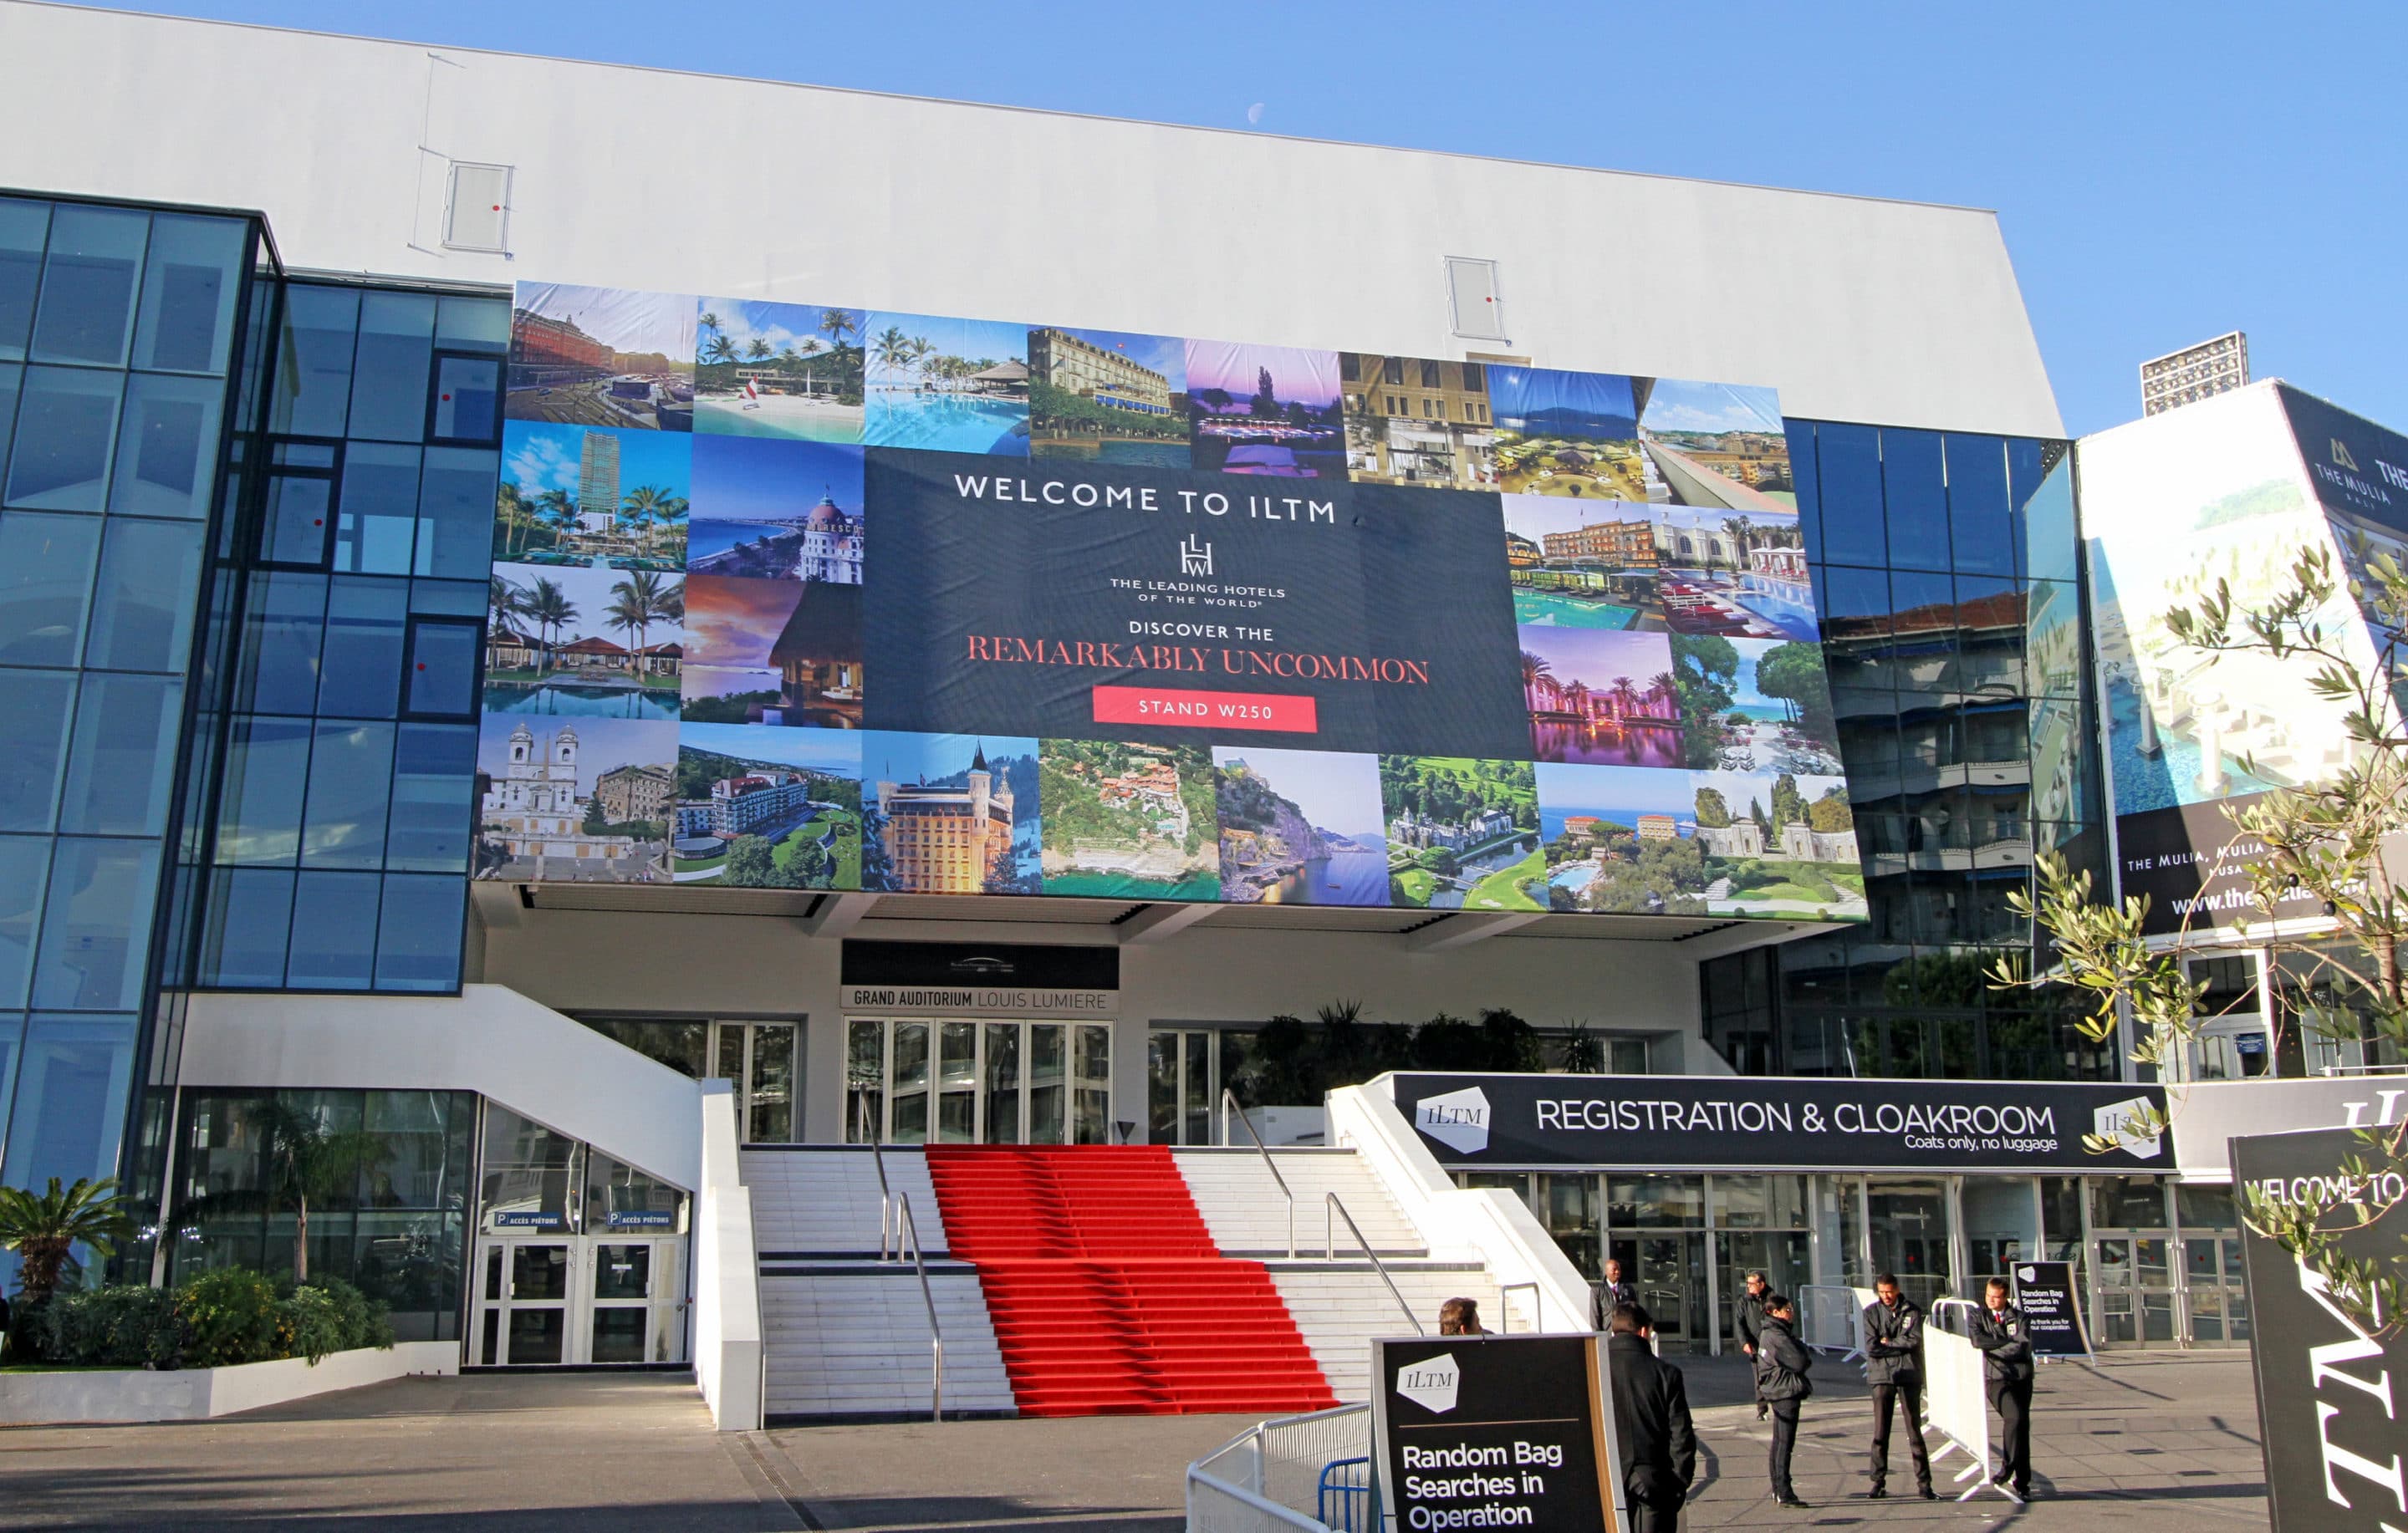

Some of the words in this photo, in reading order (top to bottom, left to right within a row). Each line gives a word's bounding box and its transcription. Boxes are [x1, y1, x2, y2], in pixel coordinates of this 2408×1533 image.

[2314, 463, 2343, 486] THE
[2344, 474, 2391, 506] MULIA
[2375, 459, 2408, 491] THE
[954, 474, 1159, 512] WELCOME
[1177, 491, 1230, 516] TO
[1250, 497, 1336, 524] ILTM
[1110, 578, 1141, 589] THE
[1148, 581, 1218, 593] LEADING
[1224, 586, 1286, 598] HOTELS
[1138, 593, 1158, 602] OF
[1166, 595, 1196, 604] THE
[1130, 621, 1229, 639] DISCOVER
[1236, 627, 1273, 641] THE
[967, 635, 1212, 673] REMARKABLY
[1223, 649, 1429, 684] UNCOMMON
[1139, 700, 1209, 716] STAND
[1218, 704, 1273, 720] W250
[2127, 858, 2152, 871] THE
[2158, 851, 2209, 868] MULIA,
[2217, 843, 2264, 858] MULIA
[855, 990, 895, 1006] GRAND
[899, 991, 972, 1006] AUDITORIUM
[977, 992, 1027, 1008] LOUIS
[1033, 993, 1107, 1010] LUMIERE
[1536, 1100, 1793, 1132] REGISTRATION
[1802, 1103, 1827, 1133] &
[1834, 1103, 2056, 1135] CLOAKROOM
[1905, 1134, 1946, 1149] Coats
[1947, 1134, 1979, 1152] only,
[1982, 1138, 2000, 1149] no
[2003, 1135, 2058, 1154] luggage
[2244, 1175, 2364, 1207] WELCOME
[2365, 1172, 2405, 1203] TO
[2049, 1290, 2064, 1298] Bag
[1402, 1443, 1508, 1469] Random
[1513, 1441, 1563, 1468] Bag
[1406, 1472, 1516, 1499] Searches
[1521, 1470, 1544, 1494] in
[1409, 1501, 1533, 1533] Operation
